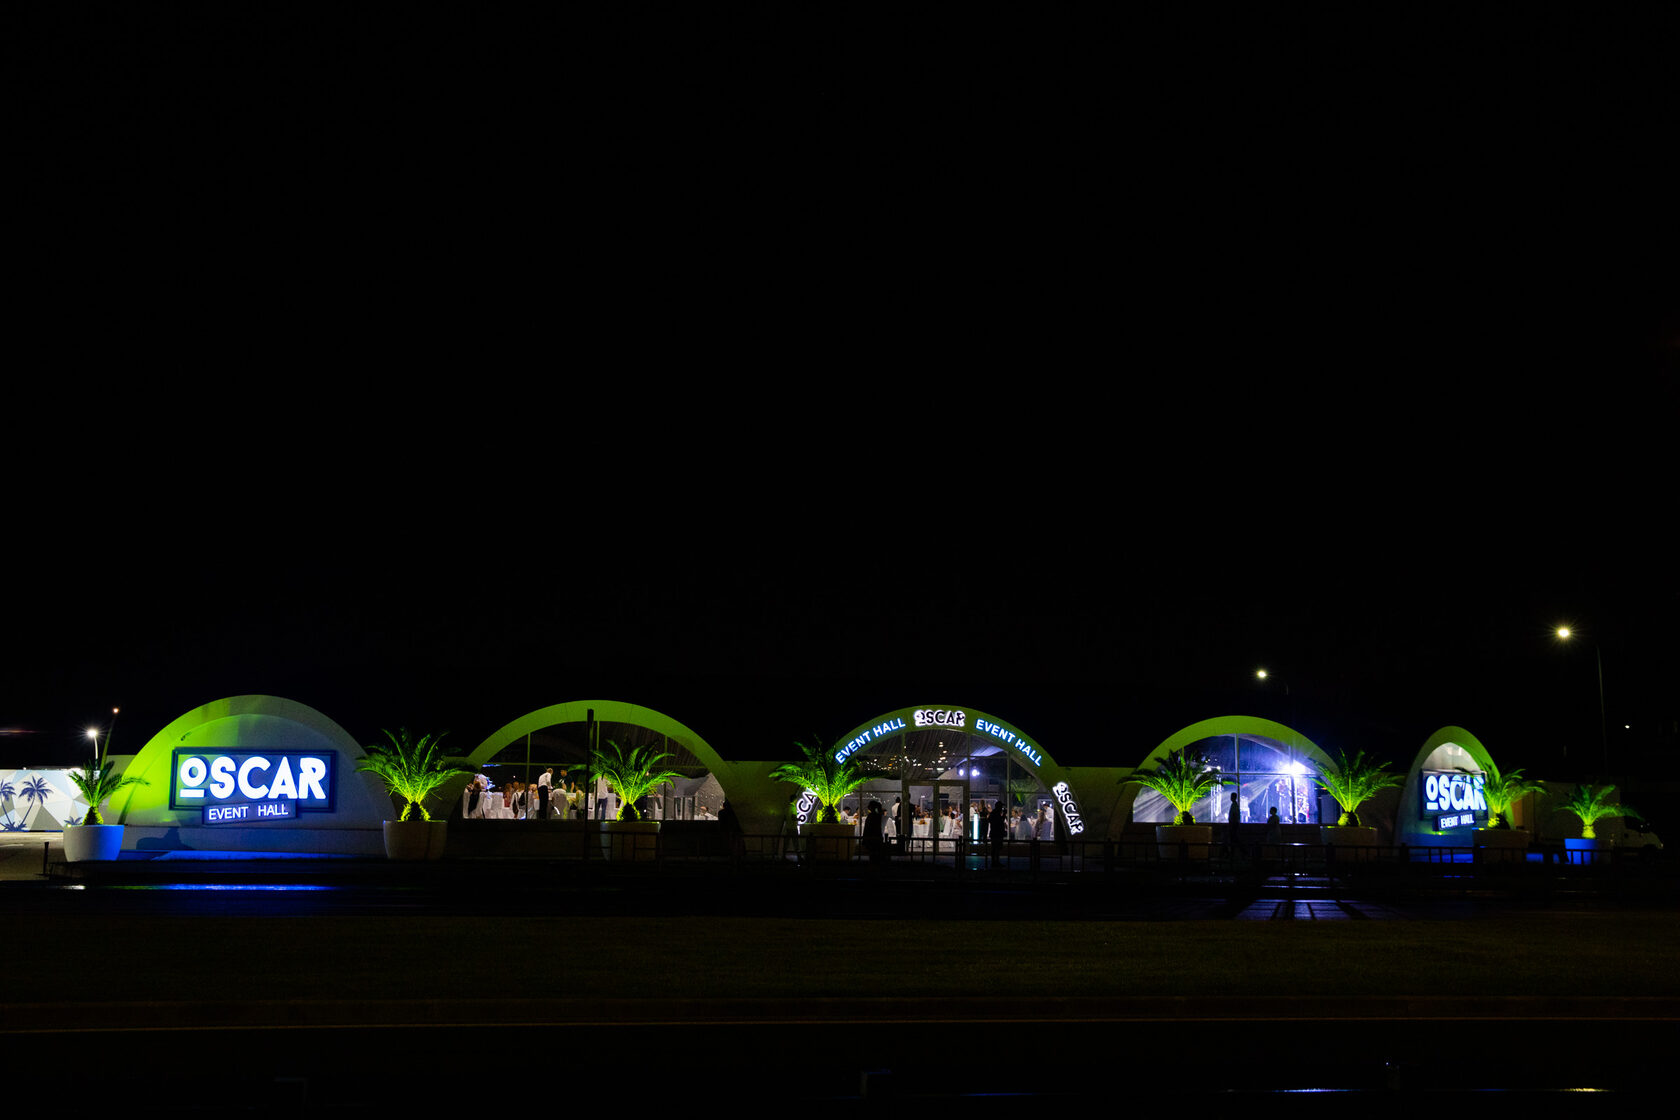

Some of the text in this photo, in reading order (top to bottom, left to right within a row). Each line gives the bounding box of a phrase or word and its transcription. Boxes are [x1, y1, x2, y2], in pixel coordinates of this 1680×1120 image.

[914, 710, 965, 726] OSCAR
[835, 718, 906, 764] EVENT HALL
[976, 719, 1042, 767] EVENT HALL
[180, 756, 326, 799] OSCAR
[1426, 775, 1487, 811] OSCAR
[208, 804, 288, 820] EVENT HALL
[1053, 782, 1084, 835] OSCAR
[1440, 816, 1459, 829] EVENT
